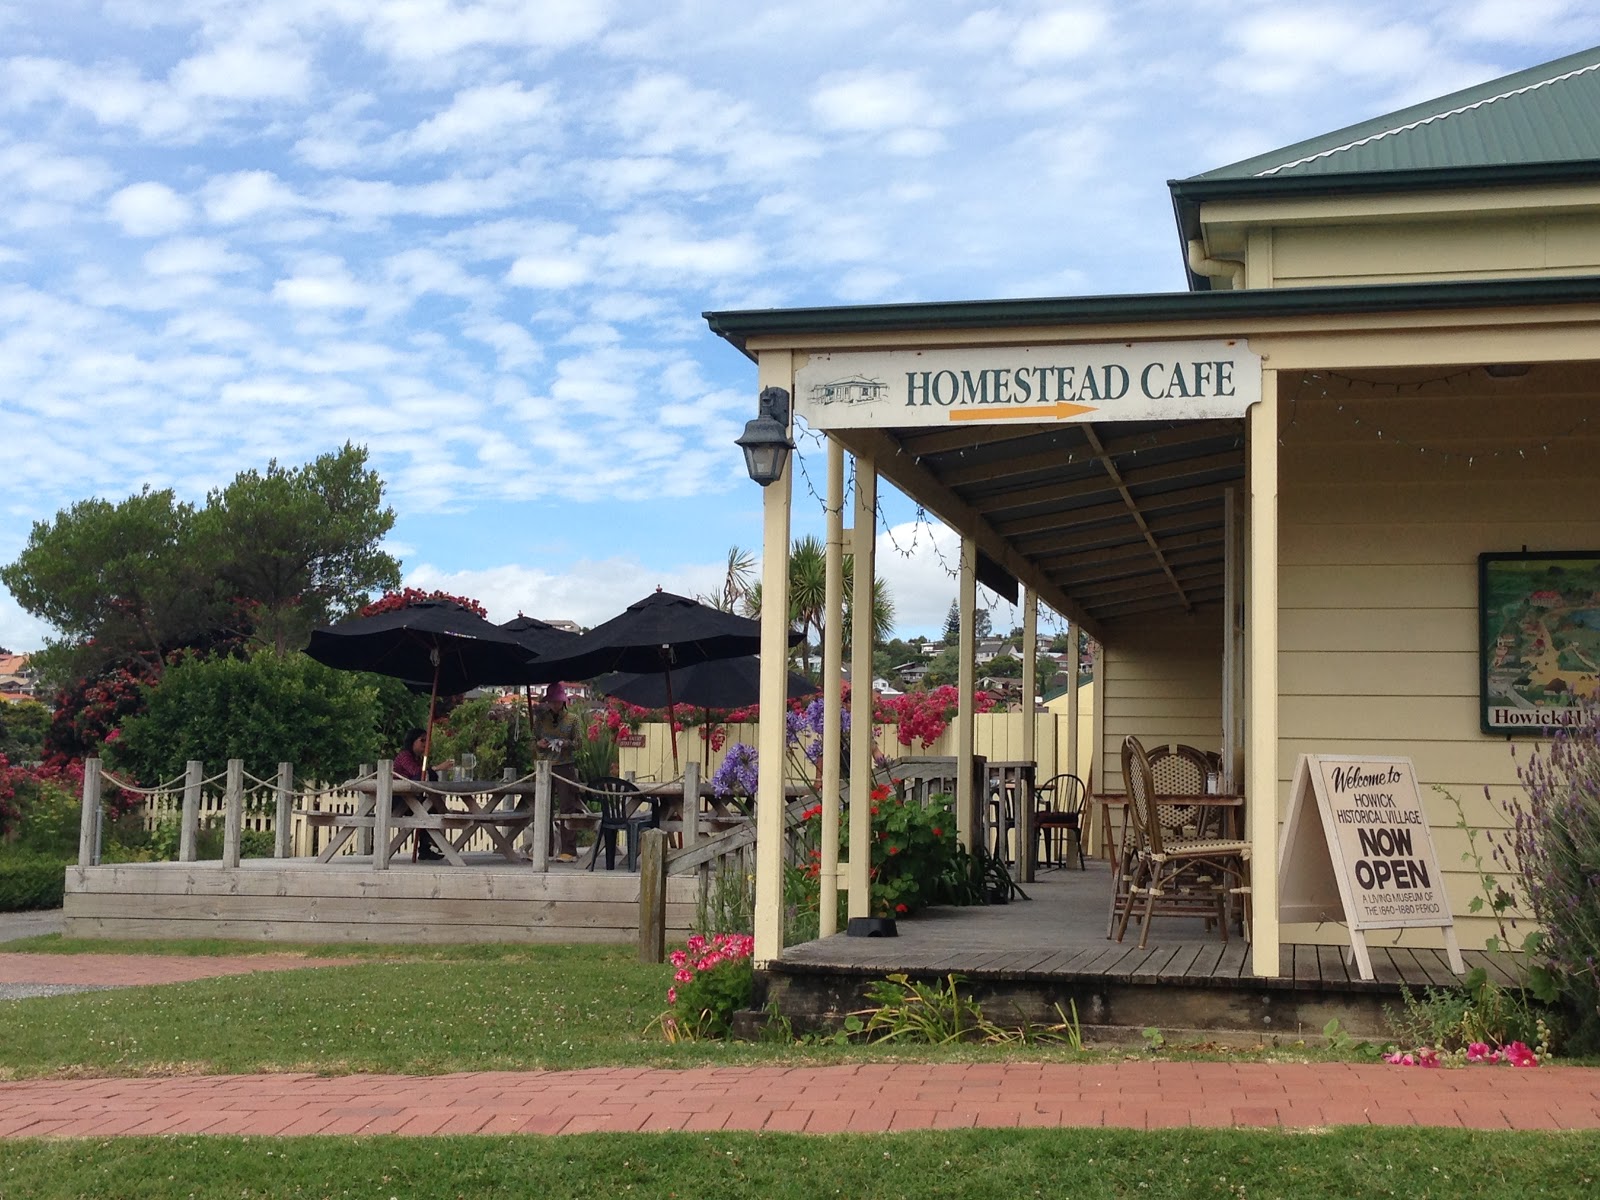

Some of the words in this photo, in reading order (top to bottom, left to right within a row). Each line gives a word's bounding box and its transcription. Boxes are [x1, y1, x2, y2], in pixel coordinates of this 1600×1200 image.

[905, 364, 1129, 406] HOMESTEAD
[1140, 361, 1236, 399] CAFE
[1495, 709, 1561, 725] Howick
[1331, 766, 1386, 793] Welcome
[1387, 765, 1402, 784] to
[1353, 793, 1397, 808] HOWICK
[1336, 809, 1386, 824] HISTORICAL
[1385, 810, 1422, 825] VILLAGE
[1357, 828, 1413, 857] NOW
[1355, 860, 1431, 890] OPEN
[1362, 894, 1367, 903] A
[1368, 893, 1392, 904] LIVING
[1392, 892, 1424, 902] MUSEUM
[1424, 891, 1434, 901] OF
[1364, 906, 1379, 916] THE
[1415, 903, 1440, 914] PERIOD
